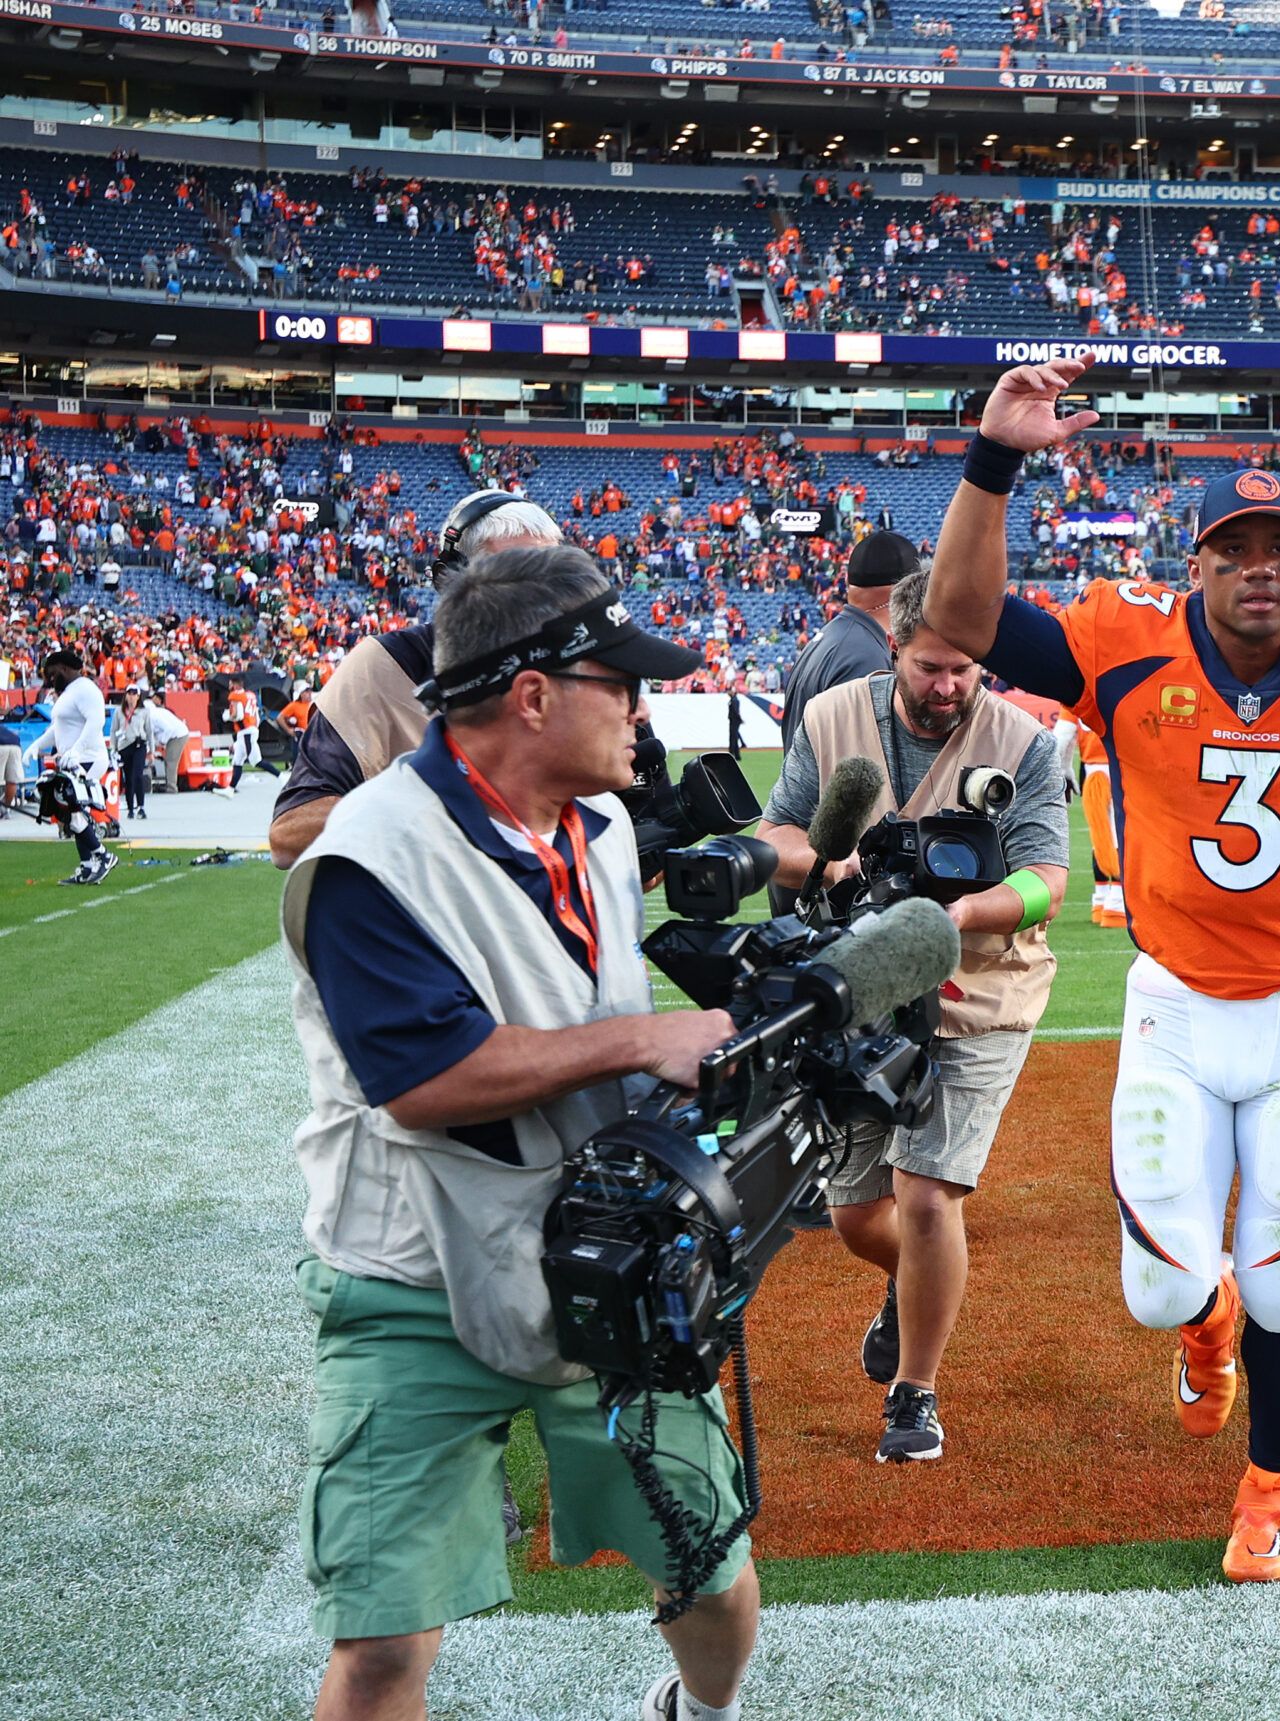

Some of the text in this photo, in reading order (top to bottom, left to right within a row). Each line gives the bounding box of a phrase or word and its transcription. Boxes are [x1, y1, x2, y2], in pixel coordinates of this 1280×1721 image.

[0, 0, 51, 19] ISHAR
[141, 16, 222, 38] 25 MOSES
[318, 37, 437, 58] 36 THOMPSON
[510, 51, 595, 68] 70 P. SMITH
[672, 60, 727, 75] PHIPPS
[823, 67, 944, 84] 87 R. JACKSON
[1019, 74, 1107, 89] 87 TAYLOR
[1180, 80, 1244, 93] 7 ELWAY
[1057, 183, 1095, 197] BUD
[1098, 184, 1151, 198] LIGHT
[1156, 184, 1267, 200] CHAMPIONS
[275, 315, 370, 342] 0:00 25
[996, 342, 1227, 366] HOMETOWN GROCER.
[60, 401, 78, 412] 111
[588, 422, 607, 433] 112
[1159, 685, 1197, 717] C
[1238, 705, 1259, 718] NFL
[1212, 729, 1280, 742] BRONCOS
